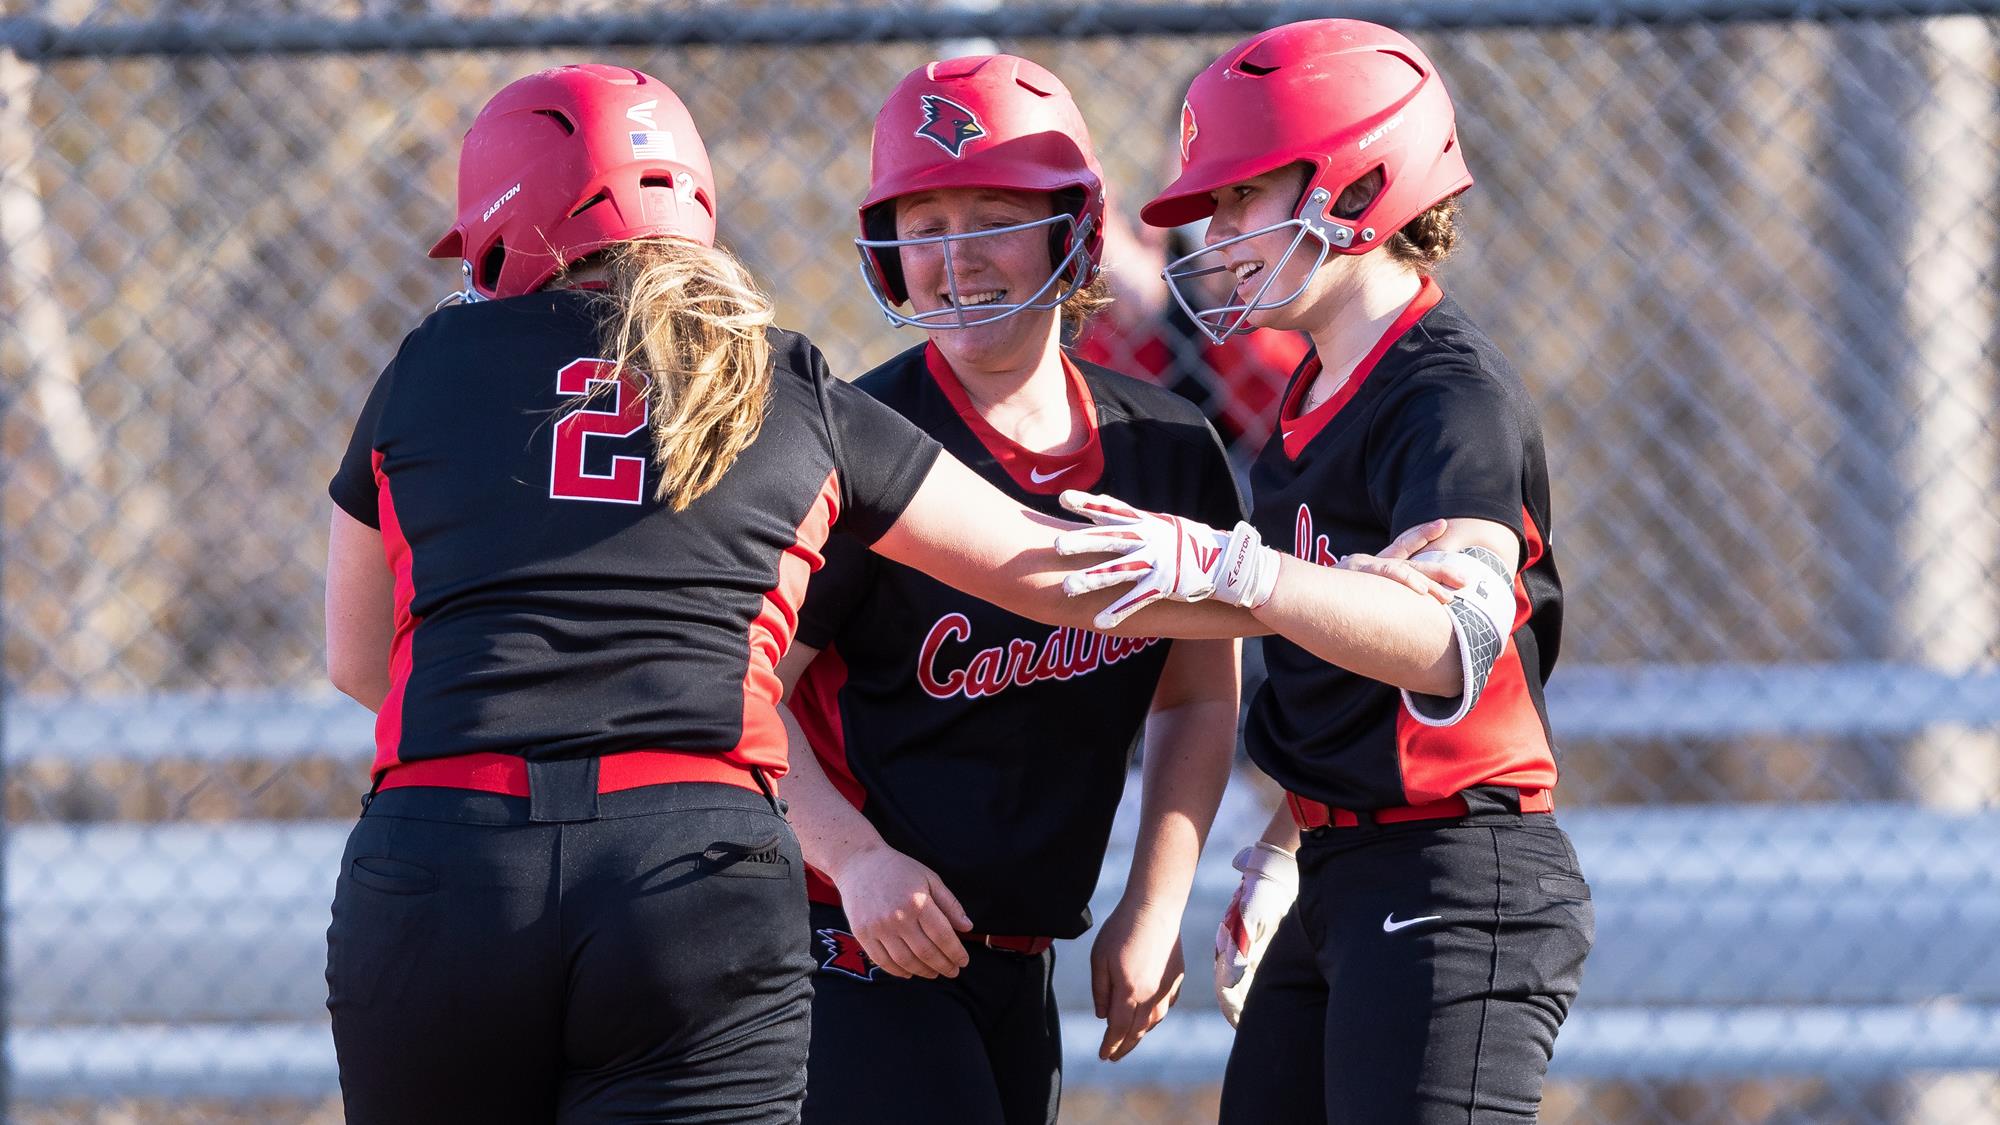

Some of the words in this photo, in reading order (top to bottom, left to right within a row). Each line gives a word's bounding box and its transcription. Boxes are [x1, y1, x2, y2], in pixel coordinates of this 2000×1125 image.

[483, 182, 521, 223] EASTON
[550, 357, 650, 505] 2
[1233, 534, 1250, 576] EASTON
